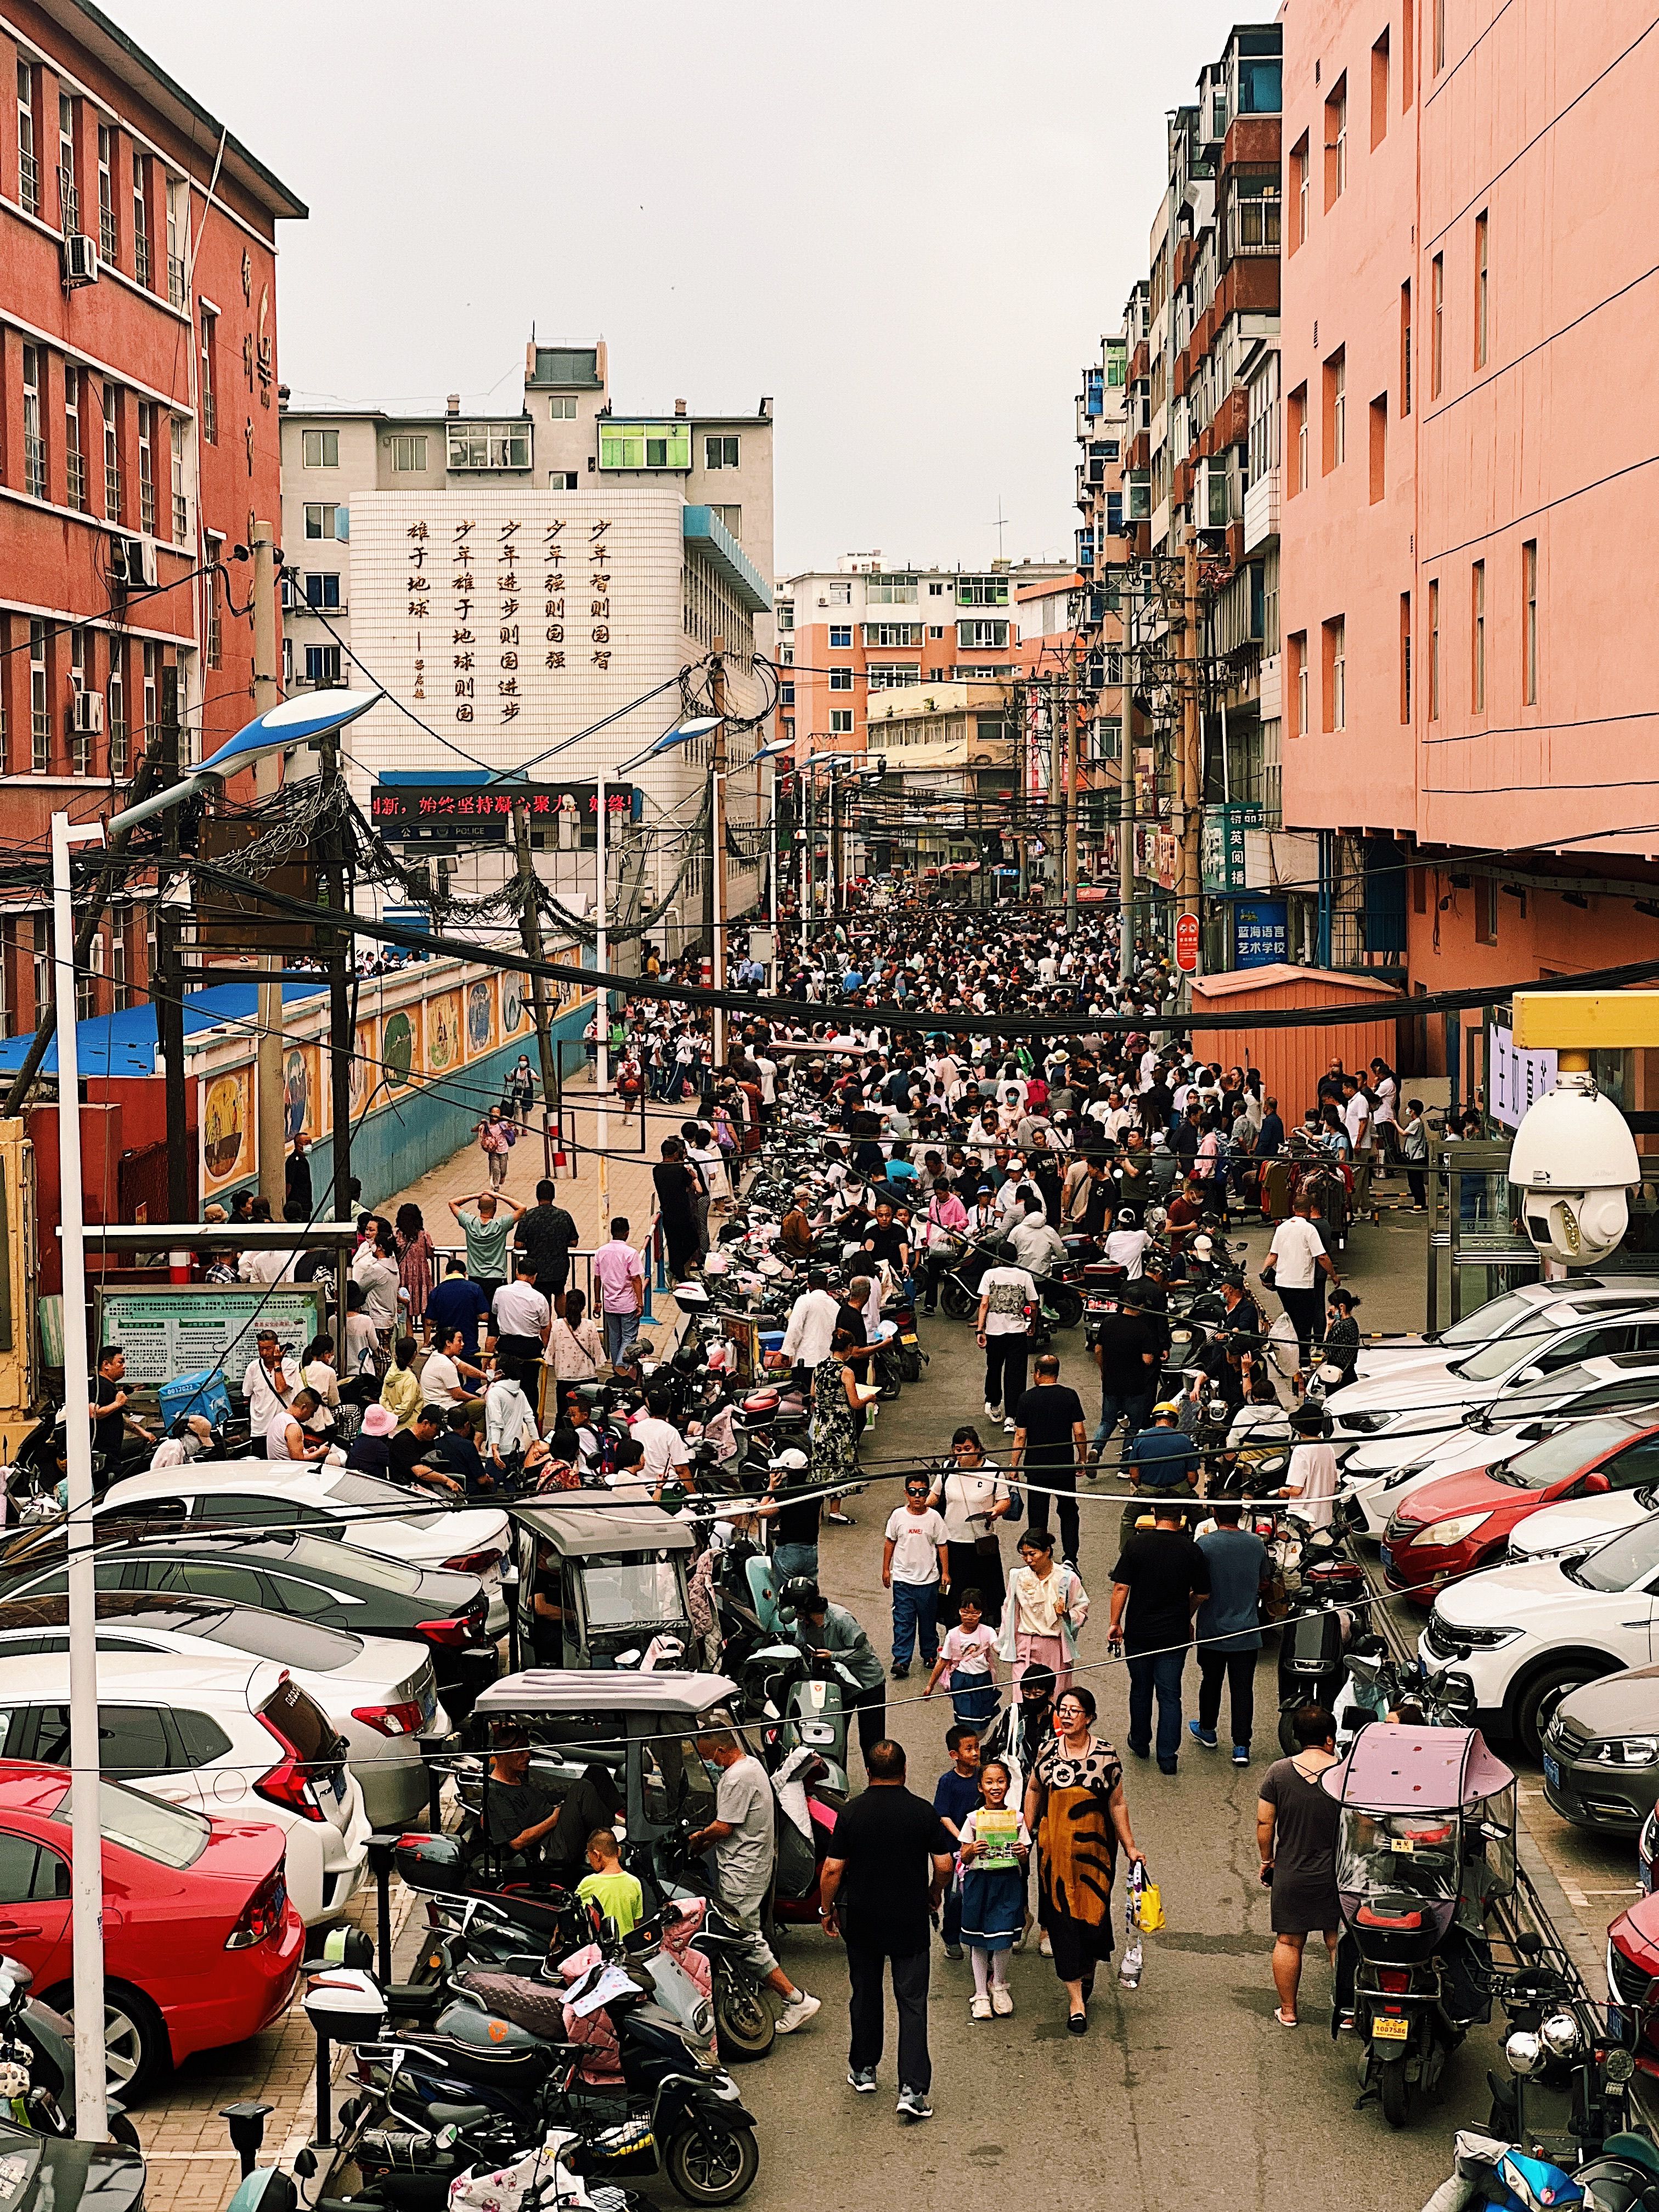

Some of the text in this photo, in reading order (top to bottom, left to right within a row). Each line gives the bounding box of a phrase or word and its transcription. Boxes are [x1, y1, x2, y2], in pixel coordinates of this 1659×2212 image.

[452, 520, 476, 723] 少年雄于地球则国
[497, 520, 521, 724] 少年进步则国进步
[543, 520, 567, 670] 少年强则国强
[588, 520, 612, 670] 少年智则国智
[456, 827, 485, 835] POLICE
[1238, 926, 1285, 938] 蓝海语言
[1238, 941, 1285, 954] 艺术学校
